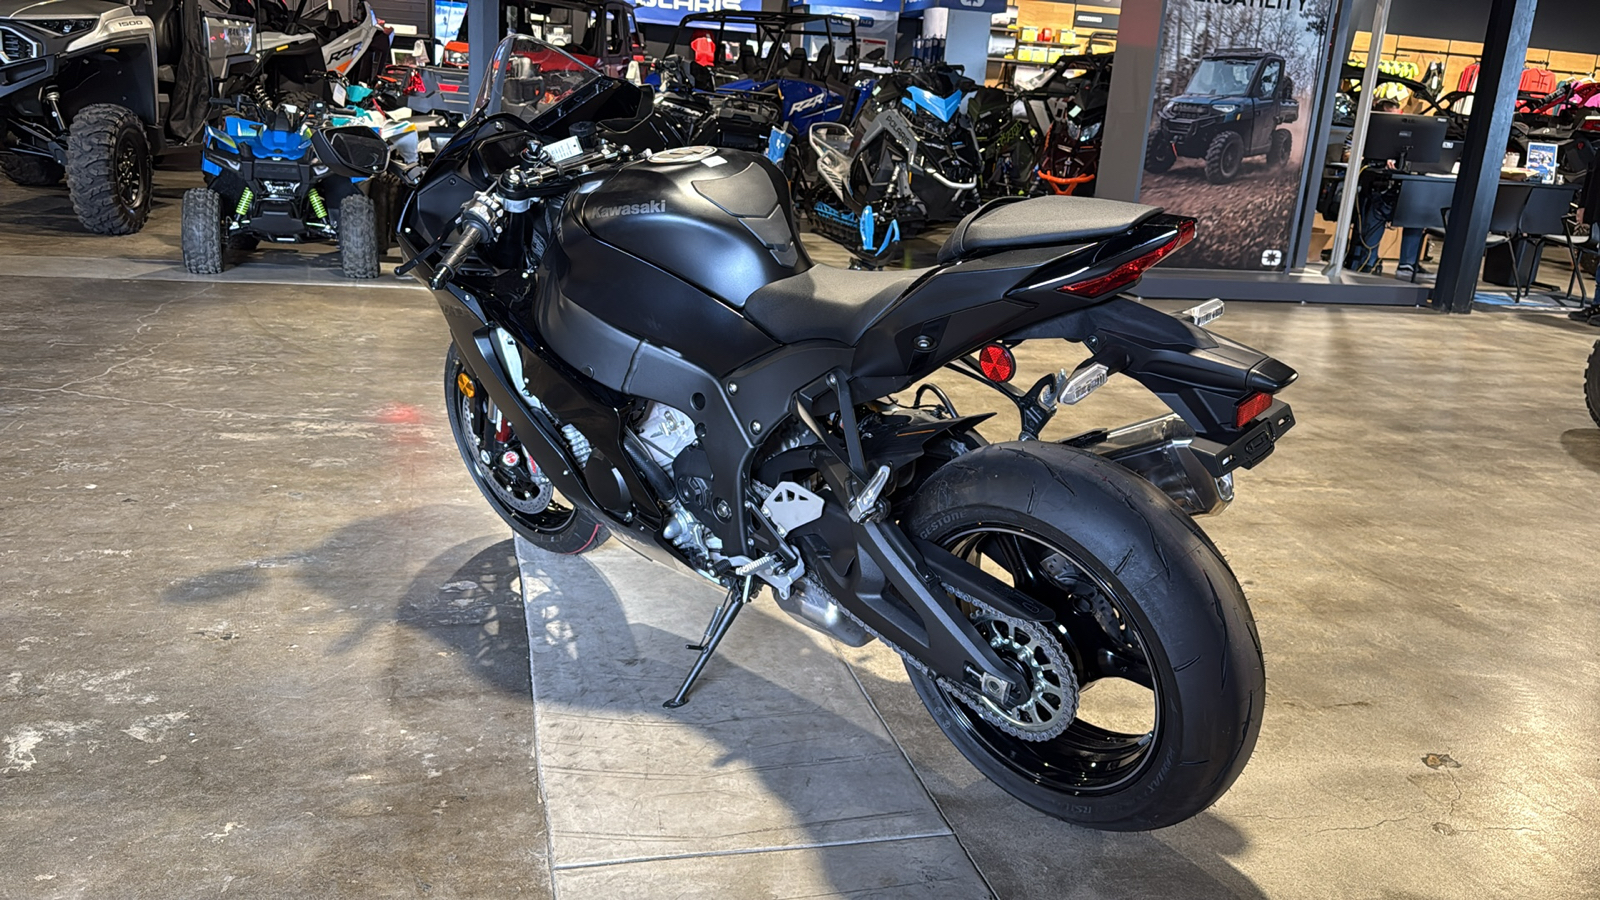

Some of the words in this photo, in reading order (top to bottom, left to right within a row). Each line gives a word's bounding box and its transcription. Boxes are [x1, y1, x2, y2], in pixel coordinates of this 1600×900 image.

[635, 0, 742, 12] OLARIS
[788, 93, 825, 116] RZR
[886, 116, 911, 145] POLARIS
[591, 200, 666, 219] Kawasaki
[919, 511, 968, 540] GESTONE
